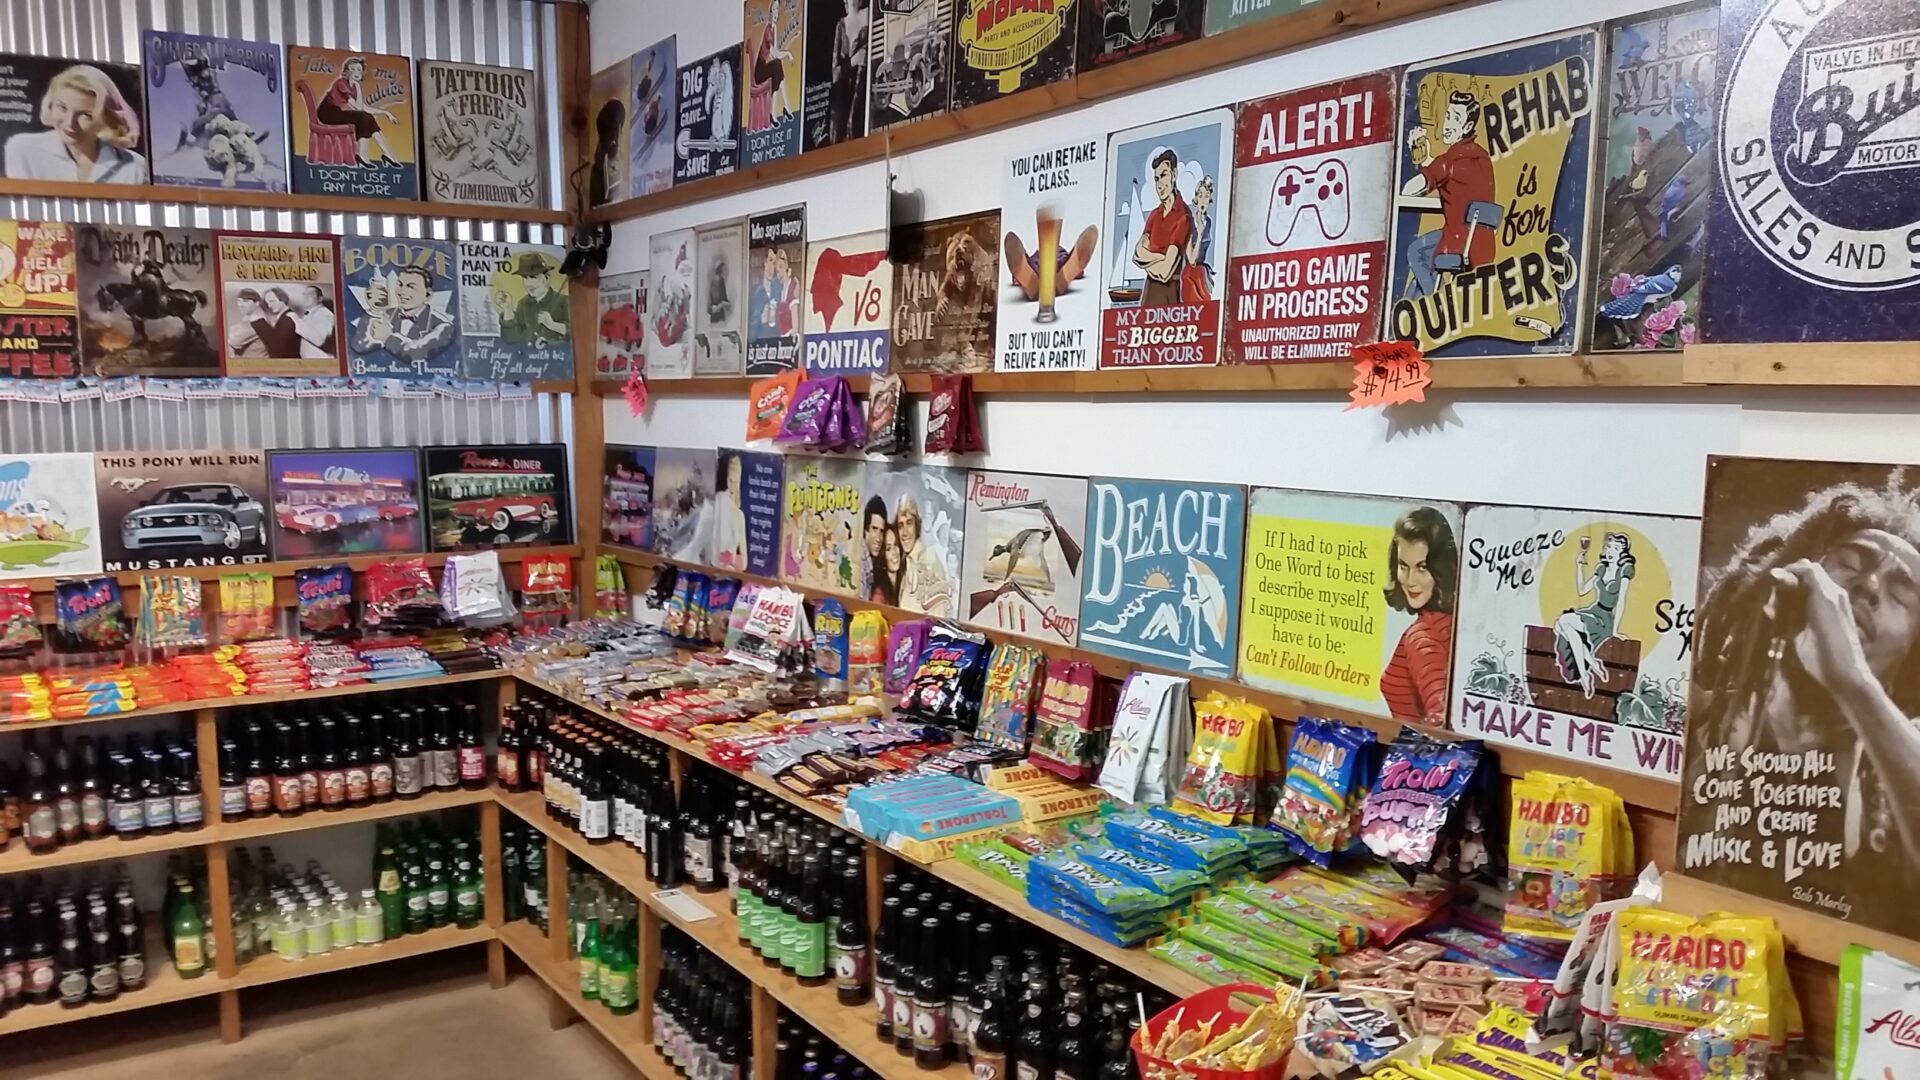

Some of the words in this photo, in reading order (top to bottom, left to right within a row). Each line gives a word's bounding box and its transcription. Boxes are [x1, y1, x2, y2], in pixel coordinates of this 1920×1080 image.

[984, 33, 999, 43] PARTS
[1000, 29, 1011, 37] AND
[1012, 16, 1046, 34] ACCESSORIES
[1813, 52, 1863, 71] VALVE
[1868, 46, 1884, 62] IN
[376, 67, 402, 87] my
[430, 67, 527, 109] TATTOOS
[682, 65, 703, 98] DIG
[366, 84, 406, 106] advice
[459, 93, 505, 121] FREE
[1482, 56, 1591, 159] REHAB
[1253, 91, 1373, 159] ALERT!
[751, 135, 770, 150] DONT
[772, 132, 784, 144] USE
[752, 151, 765, 164] ANY
[765, 144, 786, 161] MORE
[1857, 144, 1918, 165] MOTOR
[686, 152, 710, 177] SAVE!
[1012, 155, 1030, 177] YOU
[1032, 152, 1053, 172] CAN
[1055, 141, 1096, 167] RETAKE
[318, 170, 358, 182] DONT
[364, 172, 388, 184] USE
[393, 173, 403, 184] IT
[322, 182, 346, 193] ANY
[351, 184, 392, 196] MORE
[1028, 178, 1036, 194] A
[1038, 170, 1078, 192] CLASS...
[1516, 162, 1538, 197] is
[453, 182, 519, 203] TOMORROW
[1731, 138, 1820, 261] SALES
[1825, 240, 1886, 270] AND
[18, 228, 68, 243] WAKE
[751, 222, 764, 239] Who
[765, 222, 781, 241] says
[780, 217, 802, 237] happy
[1502, 199, 1549, 247] for
[78, 227, 141, 267] Death
[143, 229, 209, 269] Dealer
[221, 243, 295, 262] HOWARD,
[459, 243, 500, 259] TEACH
[503, 246, 512, 259] A
[22, 256, 66, 271] HELL
[236, 264, 248, 280] &
[252, 263, 319, 281] HOWARD
[343, 242, 454, 282] BOOZE
[461, 259, 491, 273] MAN
[496, 260, 513, 274] TO
[1241, 259, 1301, 292] VIDEO
[1306, 252, 1371, 284] GAME
[24, 273, 69, 294] UP!
[901, 263, 940, 308] MAN
[1392, 233, 1577, 354] QUITTERS
[854, 279, 882, 327] V8
[1116, 310, 1139, 327] MY
[1144, 304, 1205, 325] DINGHY
[1237, 295, 1257, 322] IN
[1262, 285, 1370, 321] PROGRESS
[893, 304, 936, 347] CAVE
[1117, 330, 1128, 344] IS
[1128, 324, 1200, 348] BIGGER
[1241, 324, 1321, 344] UNAUTHORIZED
[1323, 322, 1361, 340] ENTRY
[1, 337, 39, 350] AND
[477, 338, 495, 349] and
[755, 343, 769, 363] just
[768, 346, 777, 360] an
[1008, 333, 1027, 350] BUT
[1031, 331, 1050, 349] YOU
[1052, 329, 1084, 347] CAN'T
[1243, 345, 1269, 361] WILL
[1271, 344, 1285, 360] BE
[1287, 341, 1353, 360] ELIMINATED
[468, 348, 489, 361] he'll
[490, 350, 513, 367] play
[528, 348, 550, 361] with
[551, 349, 566, 361] his
[806, 337, 884, 370] PONTIAC
[1004, 352, 1037, 370] RELIVE
[1038, 352, 1045, 368] A
[1049, 348, 1086, 368] PARTY!
[1112, 349, 1147, 365] THAN
[1154, 346, 1204, 364] YOURS
[352, 358, 387, 375] Better
[388, 360, 412, 374] than
[410, 358, 460, 378] Therapy!
[491, 361, 507, 379] fly
[508, 362, 523, 375] all
[524, 362, 549, 377] day!
[102, 457, 136, 468] THIS
[143, 456, 184, 468] PONY
[189, 455, 224, 467] WILL
[229, 454, 260, 466] RUN
[512, 459, 542, 470] DINER
[787, 480, 859, 517] FLINTSTONES
[969, 474, 1030, 507] Remington
[1084, 483, 1232, 606] BEACH
[1264, 530, 1278, 548] If
[1279, 535, 1285, 549] I
[1289, 533, 1315, 553] had
[1319, 539, 1333, 554] to
[1337, 540, 1368, 560] pick
[1468, 529, 1566, 572] Squeeze
[105, 555, 236, 572] MUSTANG
[242, 554, 268, 565] GT
[1255, 552, 1282, 571] One
[1286, 556, 1322, 578] Word
[1326, 562, 1340, 579] to
[1344, 563, 1376, 585] best
[1496, 565, 1535, 591] Me
[1258, 576, 1314, 601] describe
[1318, 588, 1370, 612] myself,
[1041, 606, 1078, 637] Guns
[1250, 597, 1257, 614] I
[1259, 604, 1312, 625] suppose
[1315, 609, 1326, 627] it
[1330, 614, 1374, 635] would
[1272, 624, 1304, 646] have
[1308, 632, 1321, 649] to
[1326, 634, 1347, 655] be:
[1246, 644, 1278, 667] Can't
[1279, 651, 1323, 676] Follow
[1324, 660, 1371, 687] Orders
[1461, 697, 1554, 747] MAKE
[1567, 718, 1615, 760] ME
[1381, 759, 1460, 790] Trolli
[1705, 744, 1737, 773] WE
[1740, 744, 1802, 778] SHOULD
[1802, 749, 1836, 780] ALL
[1693, 773, 1744, 805] COME
[1749, 775, 1843, 809] TOGETHER
[1715, 803, 1752, 832] AND
[1757, 806, 1818, 837] CREATE
[1685, 831, 1752, 870] MUSIC
[1761, 840, 1778, 869] &
[1784, 836, 1843, 883] LOVE
[1791, 886, 1814, 903] Bob
[1815, 890, 1853, 920] Marley
[1630, 930, 1746, 972] HARIBO
